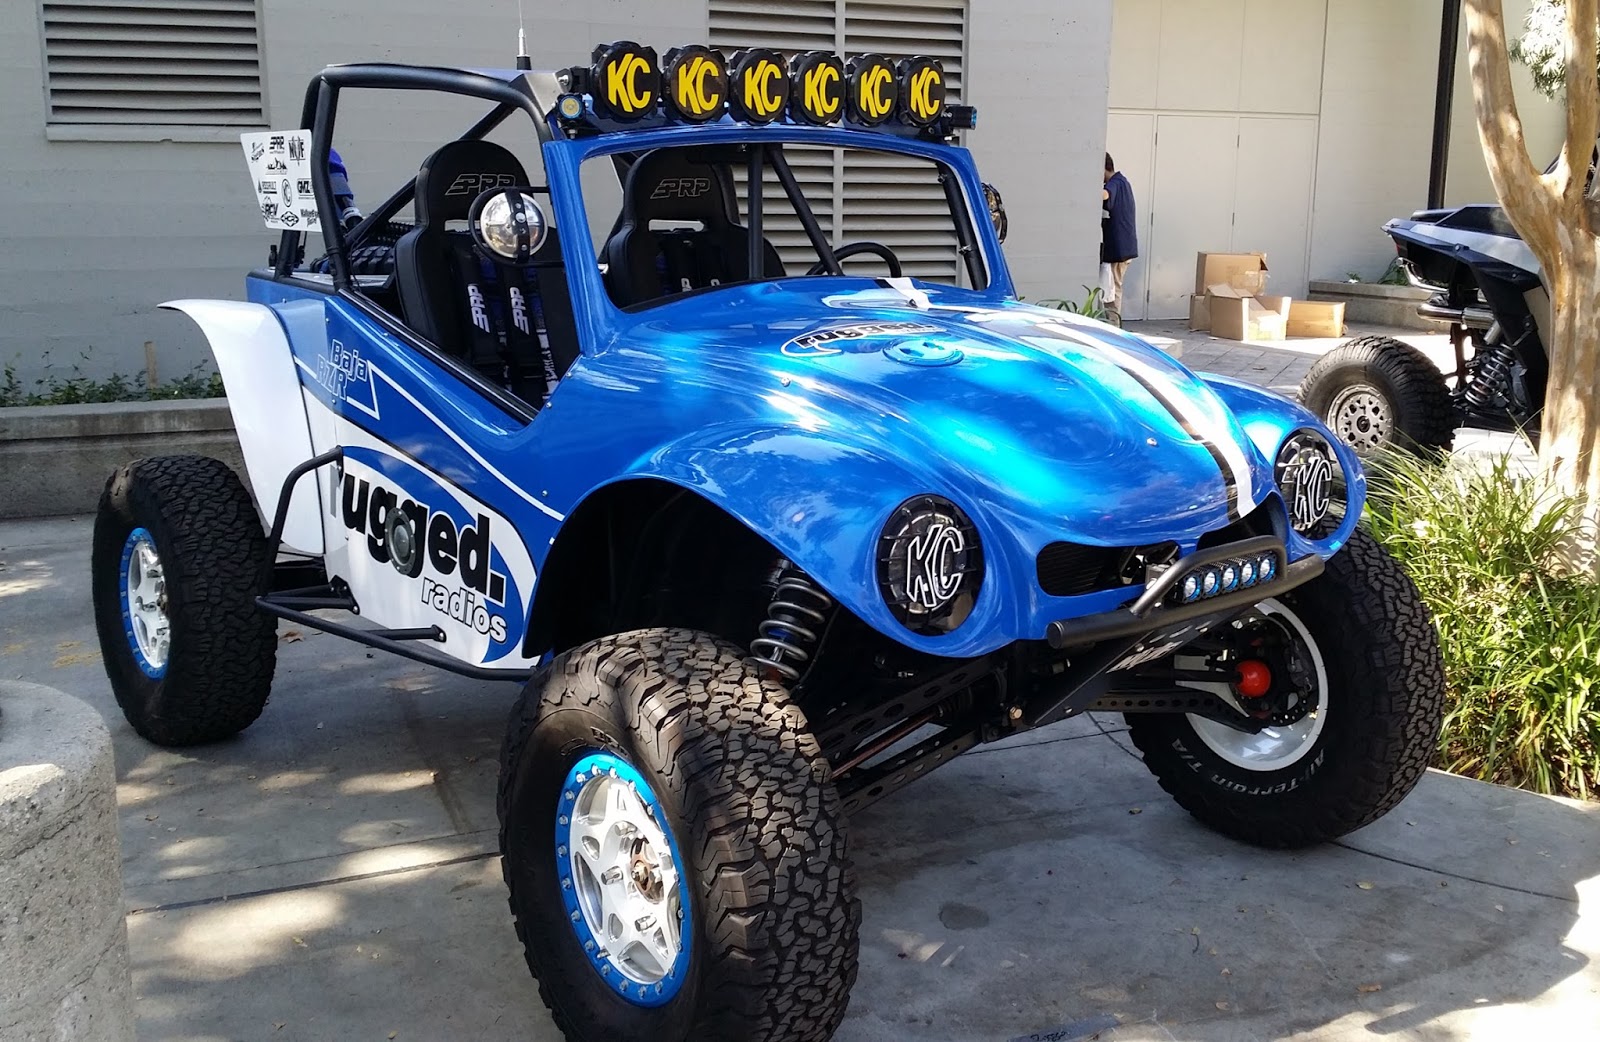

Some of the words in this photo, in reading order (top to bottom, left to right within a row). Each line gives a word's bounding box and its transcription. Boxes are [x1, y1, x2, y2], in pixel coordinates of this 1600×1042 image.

[607, 53, 651, 112] KC
[678, 57, 719, 115] KC
[744, 60, 782, 117] KC
[804, 63, 840, 118] KC
[860, 65, 892, 118] KC
[910, 67, 942, 119] KC
[445, 173, 516, 196] PRP
[650, 177, 711, 200] PRP
[467, 284, 491, 333] PRP
[508, 286, 530, 336] PRP
[316, 354, 349, 401] RZR
[331, 338, 368, 383] Baja
[1294, 456, 1332, 526] KC
[906, 524, 964, 608] KC
[421, 576, 509, 644] radios
[1171, 737, 1204, 774] T/A
